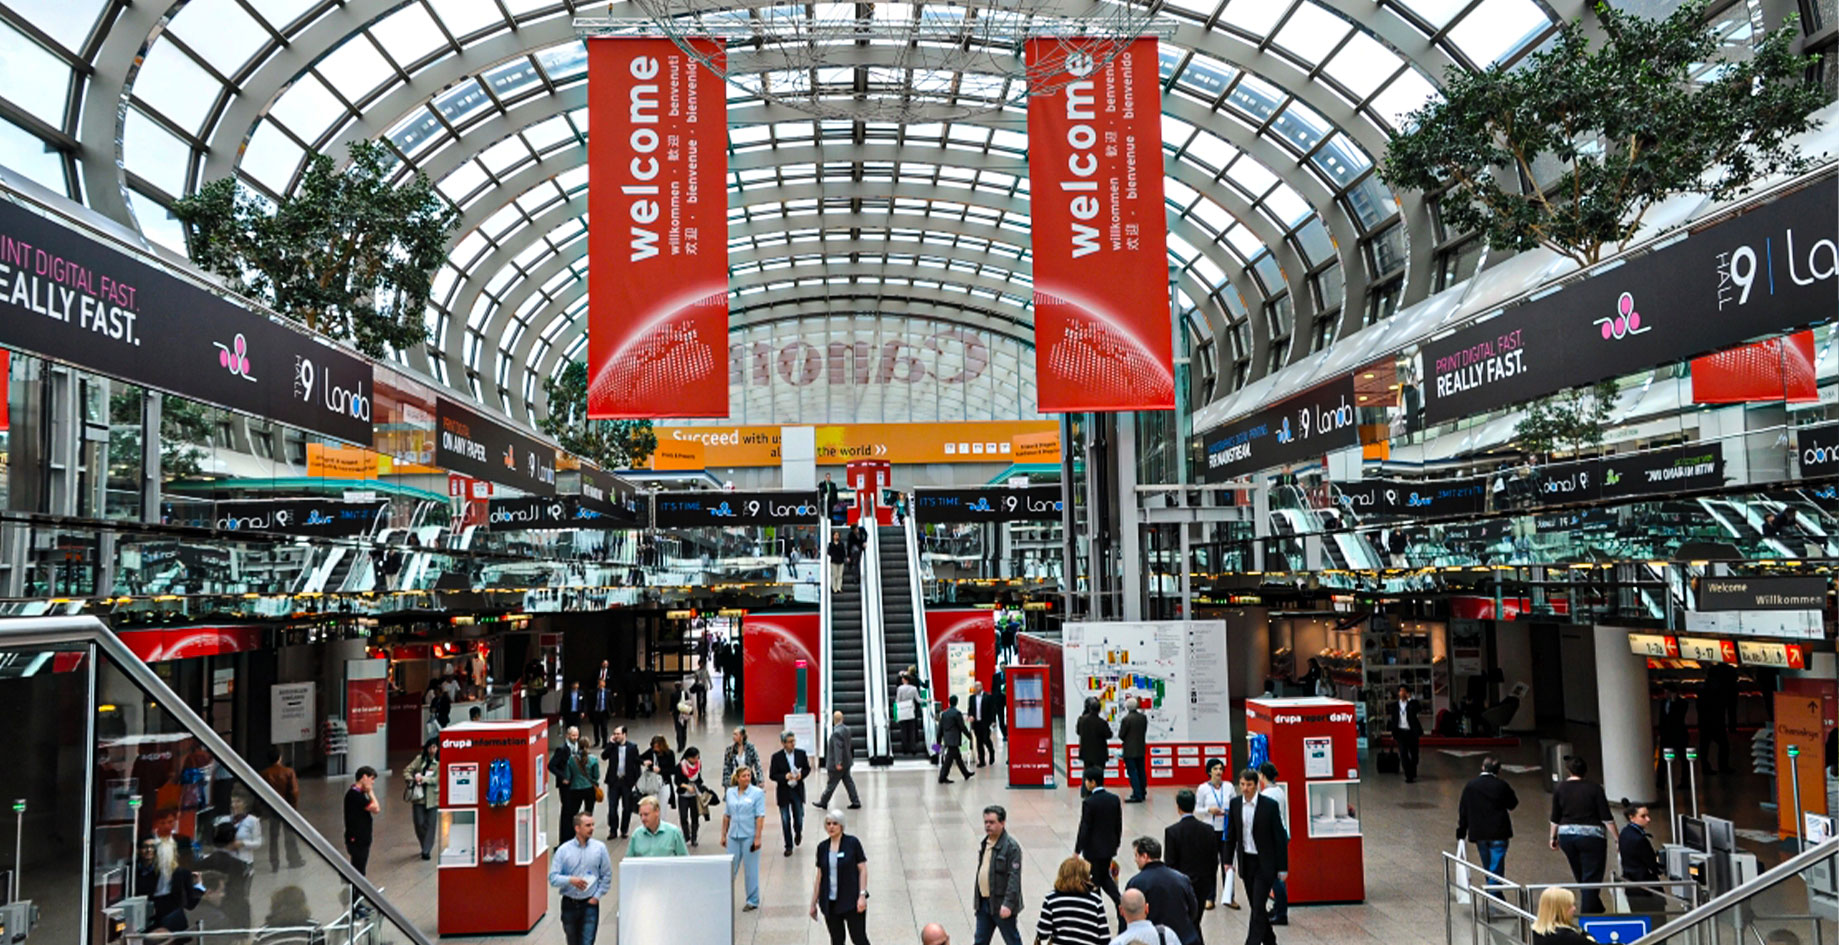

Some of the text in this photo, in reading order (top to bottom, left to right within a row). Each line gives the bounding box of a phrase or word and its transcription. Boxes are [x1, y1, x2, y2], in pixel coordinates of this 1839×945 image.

[668, 55, 680, 117] benvenuti
[1104, 58, 1117, 112] benvenu
[1122, 52, 1135, 120] bienvenido
[621, 55, 659, 263] welcome
[687, 140, 698, 204] bienvenue
[1060, 52, 1101, 259] welcome
[1125, 136, 1138, 199] bienvenue
[670, 181, 681, 255] willkommen
[1109, 177, 1121, 252] willkommen
[0, 235, 141, 314] INT DIGITAL FAST.
[1715, 228, 1838, 312] HALL 9 La
[0, 263, 142, 348] EALLY FAST.
[1435, 329, 1525, 375] PRINT DIGITAL FAST.
[1436, 349, 1527, 398] REALLY FAST.
[301, 359, 314, 402] 9
[324, 366, 371, 423] Landa
[1302, 408, 1311, 439] 9
[1316, 394, 1354, 435] Landa
[443, 430, 454, 451] ON
[672, 430, 739, 447] Succeed
[743, 432, 769, 446] with
[770, 444, 872, 460] al the world
[748, 500, 761, 517] 9
[768, 498, 818, 517] Landa
[919, 496, 936, 507] IT'S
[1006, 495, 1018, 513] 9
[1707, 582, 1749, 593] Welcome
[1755, 595, 1824, 607] Willkommen
[442, 736, 527, 750] drupainformation
